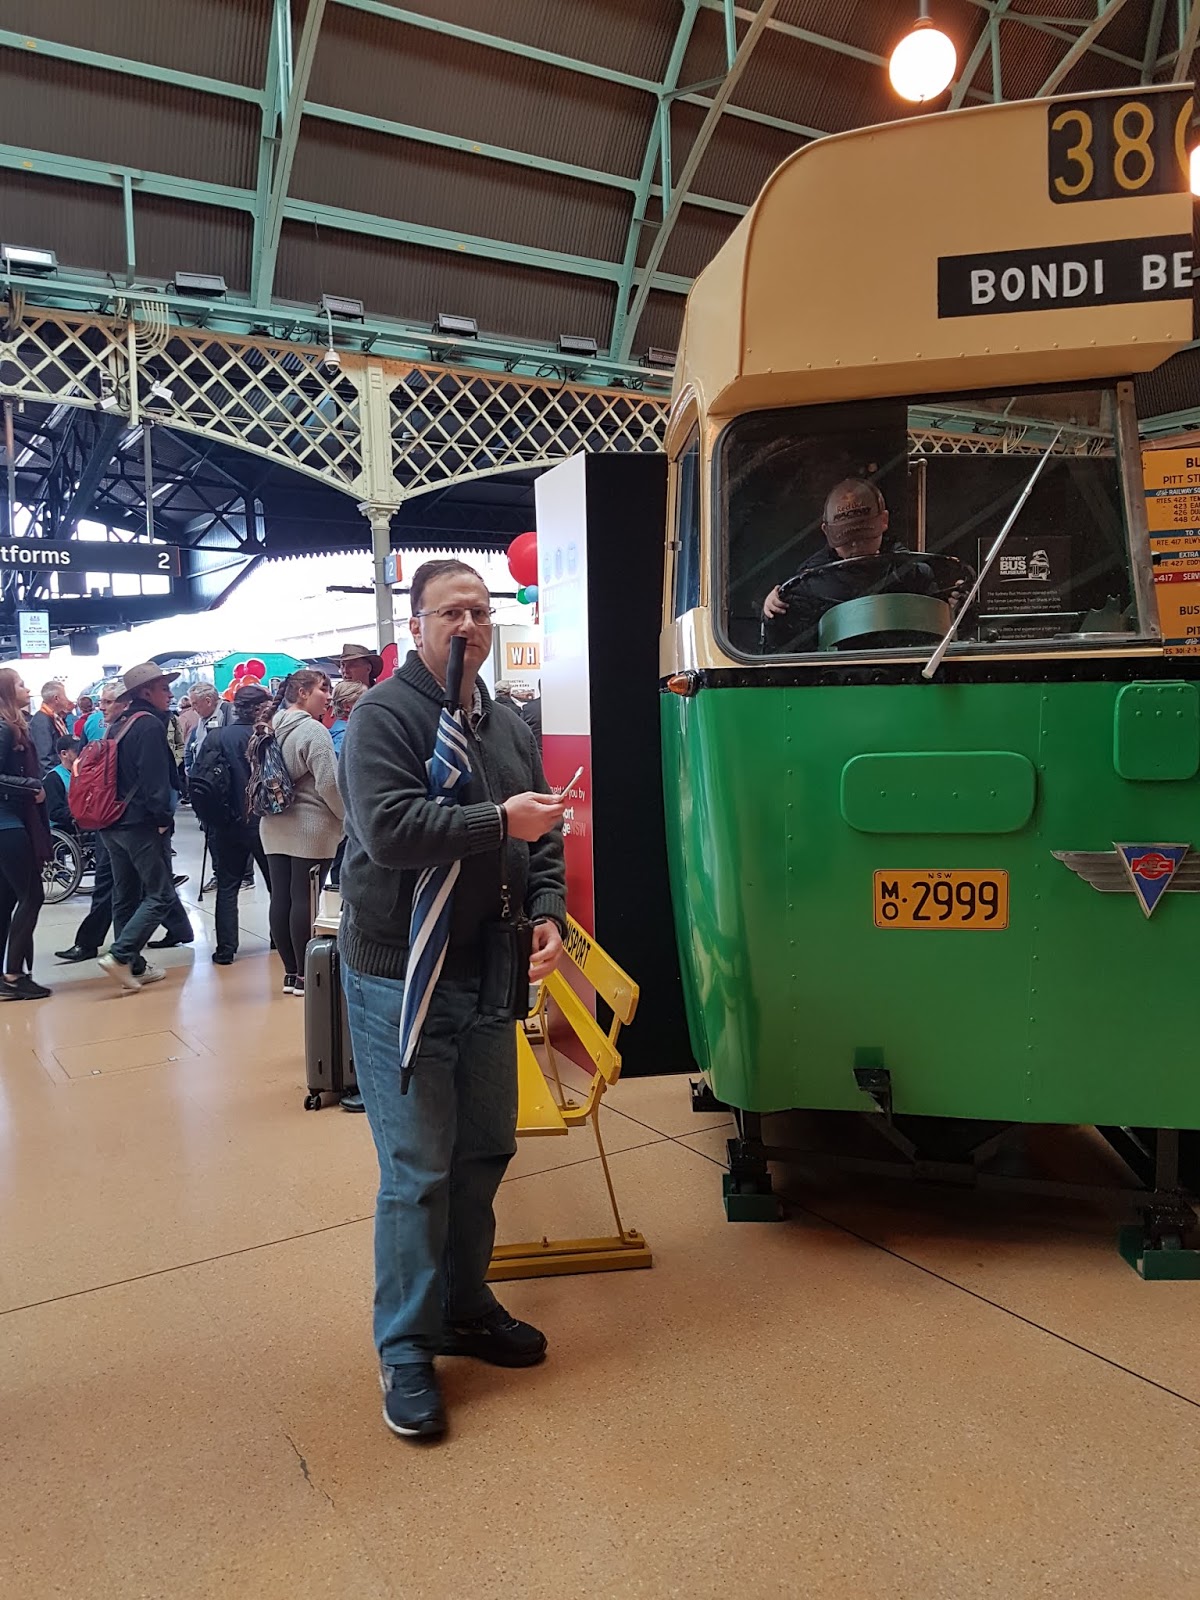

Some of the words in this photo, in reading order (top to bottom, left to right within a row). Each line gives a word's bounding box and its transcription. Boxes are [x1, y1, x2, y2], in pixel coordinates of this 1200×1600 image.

[970, 259, 1103, 304] BONDI
[1142, 251, 1193, 291] BE
[1163, 475, 1183, 484] PITT
[0, 545, 70, 565] tforms
[157, 552, 170, 570] 2
[388, 561, 394, 577] 2
[1000, 561, 1026, 570] BUS
[1180, 606, 1200, 615] BUS
[511, 647, 540, 665] WH
[579, 787, 586, 802] by
[563, 806, 574, 820] ort
[1135, 861, 1170, 871] AEC
[911, 881, 998, 921] 2999
